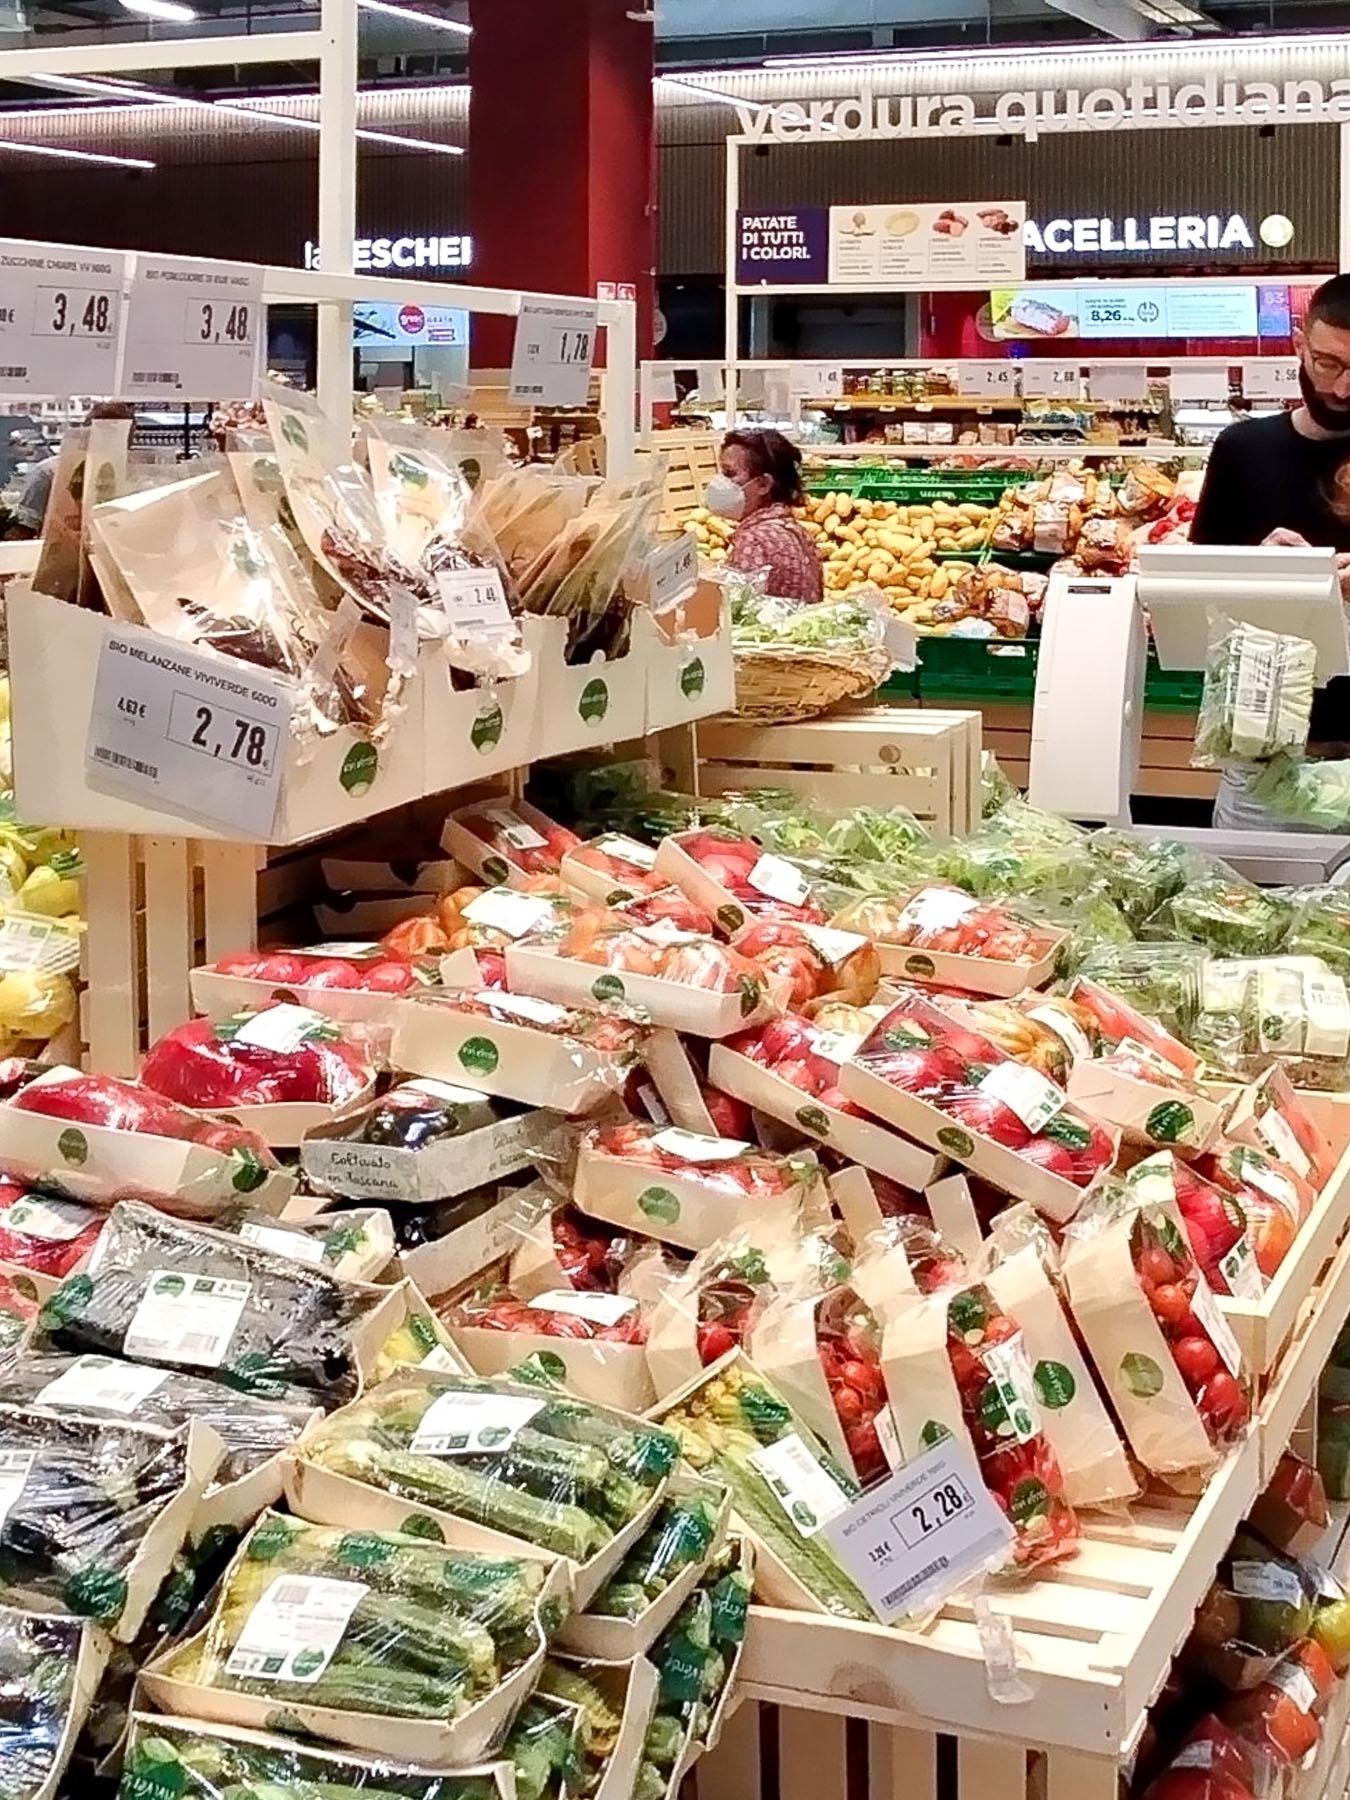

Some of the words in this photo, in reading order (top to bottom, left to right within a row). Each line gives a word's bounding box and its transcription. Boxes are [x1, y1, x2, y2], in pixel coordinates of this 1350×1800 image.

[735, 88, 975, 142] verdura
[742, 232, 759, 245] DI
[761, 231, 804, 245] TUTTI
[743, 216, 797, 230] PATATE
[742, 247, 747, 260] I
[750, 246, 811, 260] COLORI.
[53, 292, 110, 337] 3,48
[200, 303, 248, 345] 3,48
[1091, 310, 1122, 323] 8,26
[560, 332, 589, 365] 1,78
[108, 639, 127, 655] BIO
[129, 646, 193, 679] MELANZANE
[194, 669, 249, 699] VIVIVERDE
[191, 707, 266, 766] 2,78
[912, 1484, 963, 1533] 2,28
